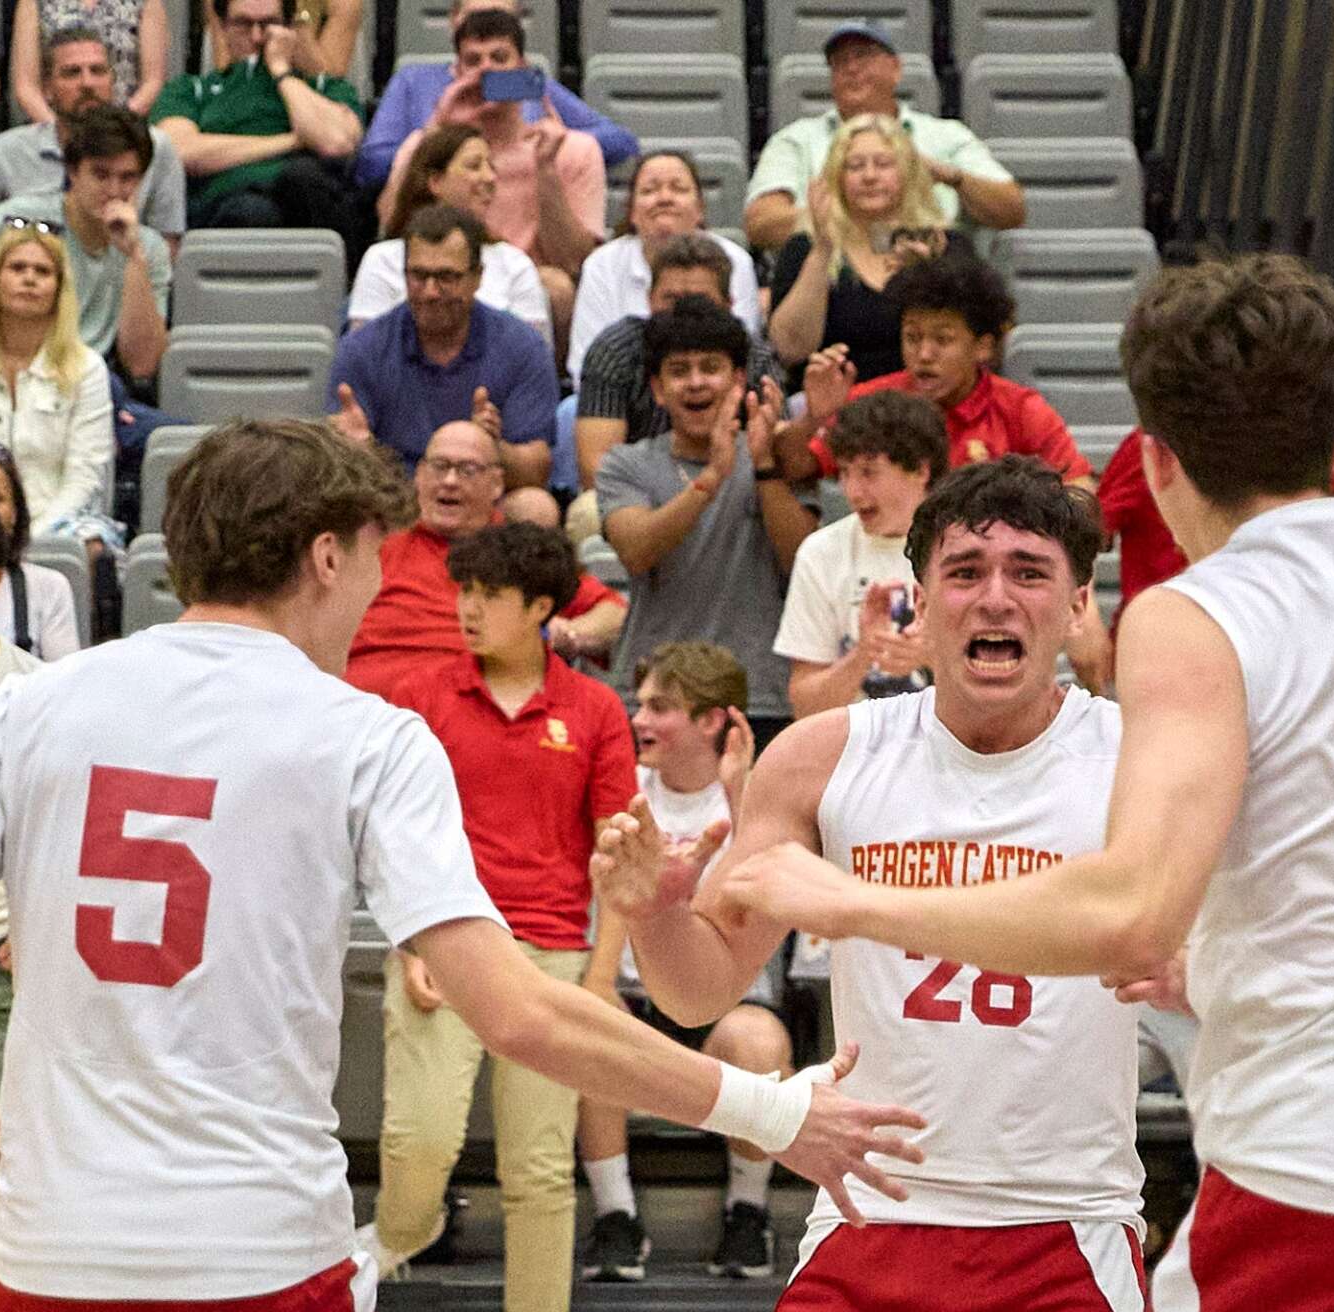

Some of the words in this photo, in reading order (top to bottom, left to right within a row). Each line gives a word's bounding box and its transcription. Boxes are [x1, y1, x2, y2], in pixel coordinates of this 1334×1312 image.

[75, 765, 219, 988] 5
[851, 840, 958, 889] BERGEN
[961, 842, 1063, 888] CATHO
